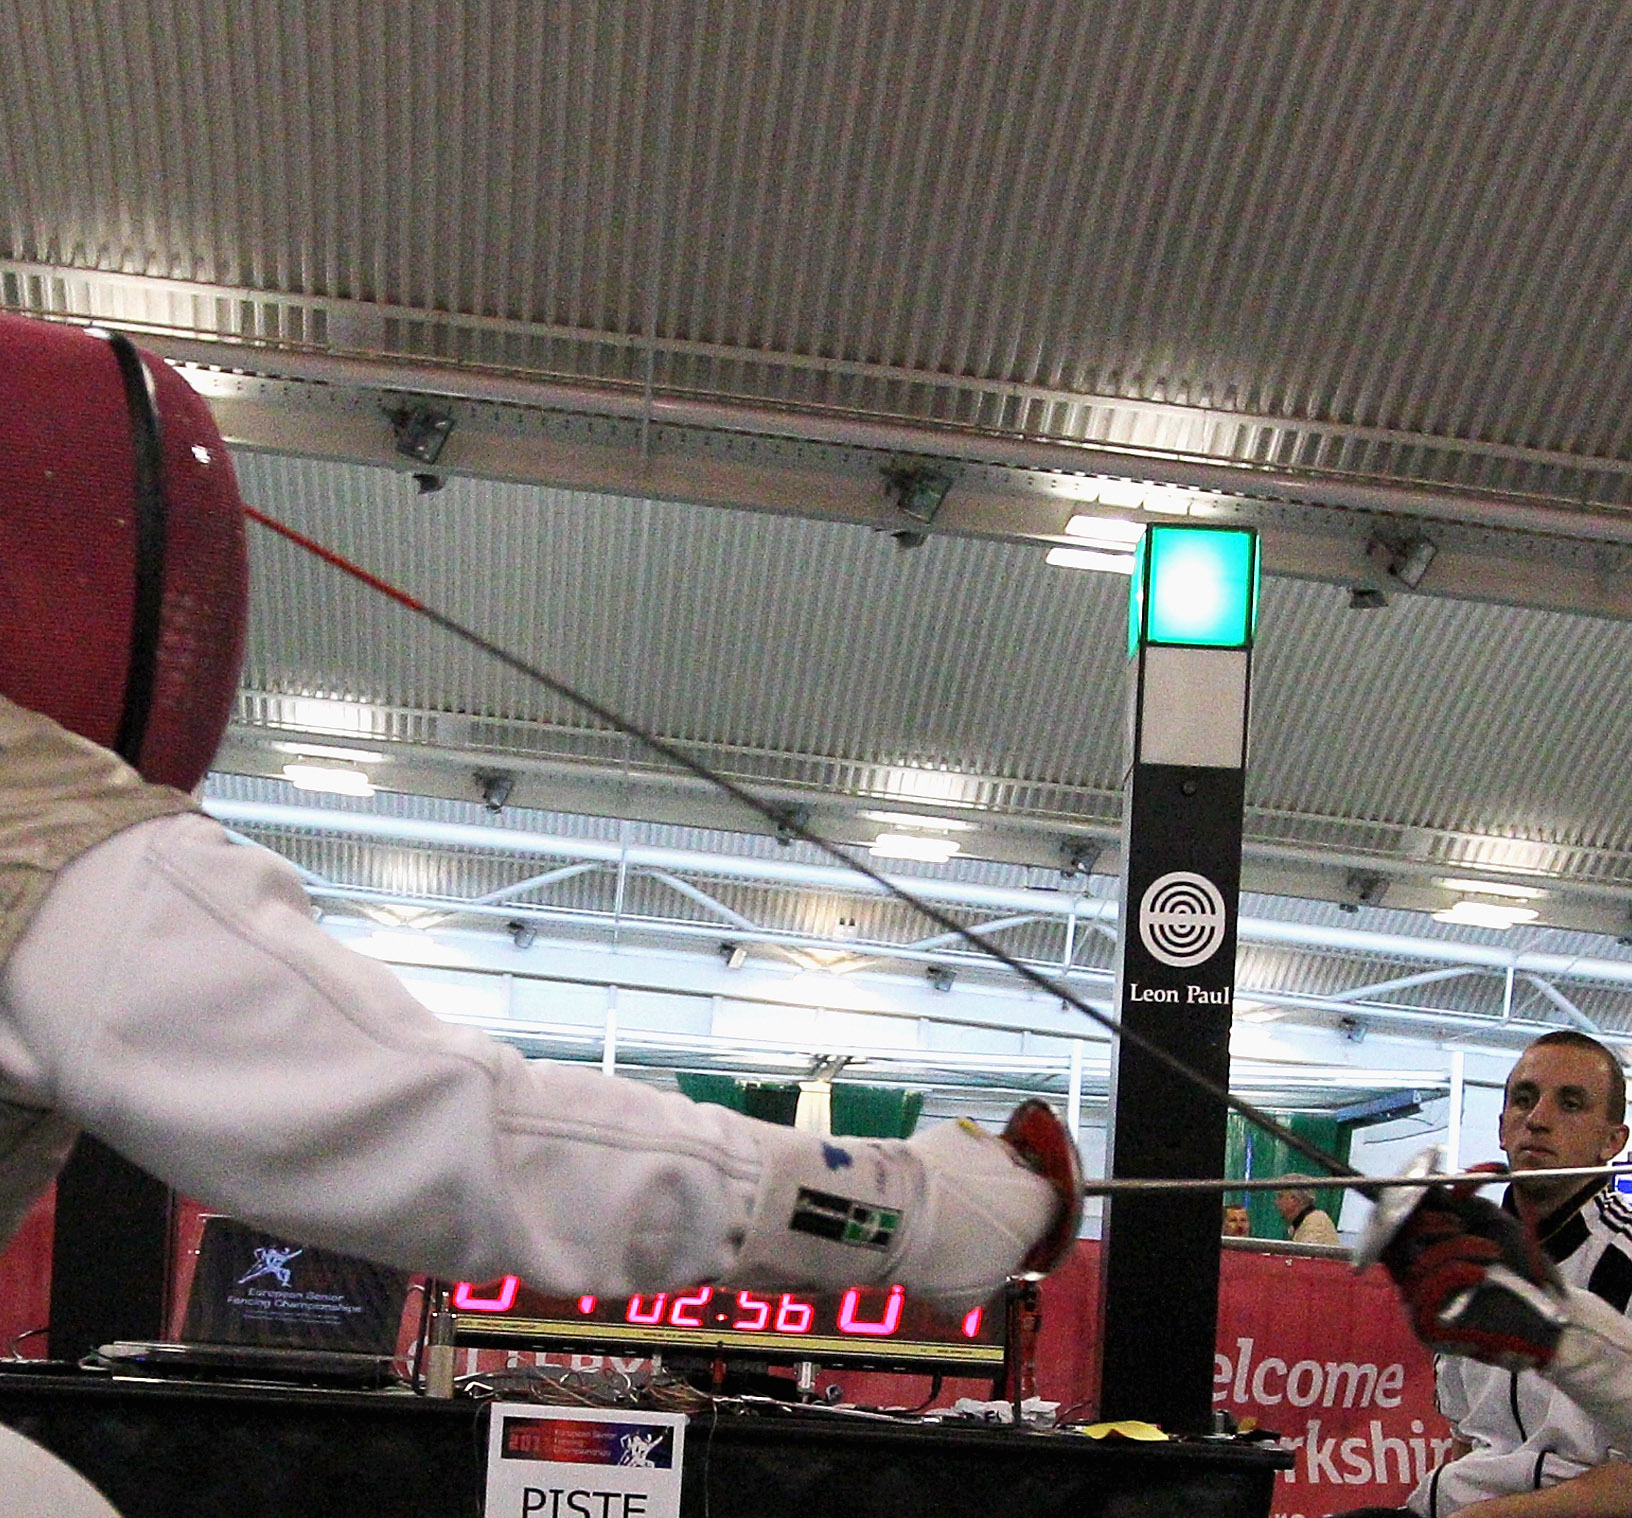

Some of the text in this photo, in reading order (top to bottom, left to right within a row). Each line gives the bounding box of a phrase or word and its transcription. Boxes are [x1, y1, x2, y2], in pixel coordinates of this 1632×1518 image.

[1130, 983, 1230, 1005] Leon Paul
[227, 1296, 271, 1309] Fencing
[1213, 1337, 1405, 1409] elcome
[1278, 1419, 1455, 1485] rkshir
